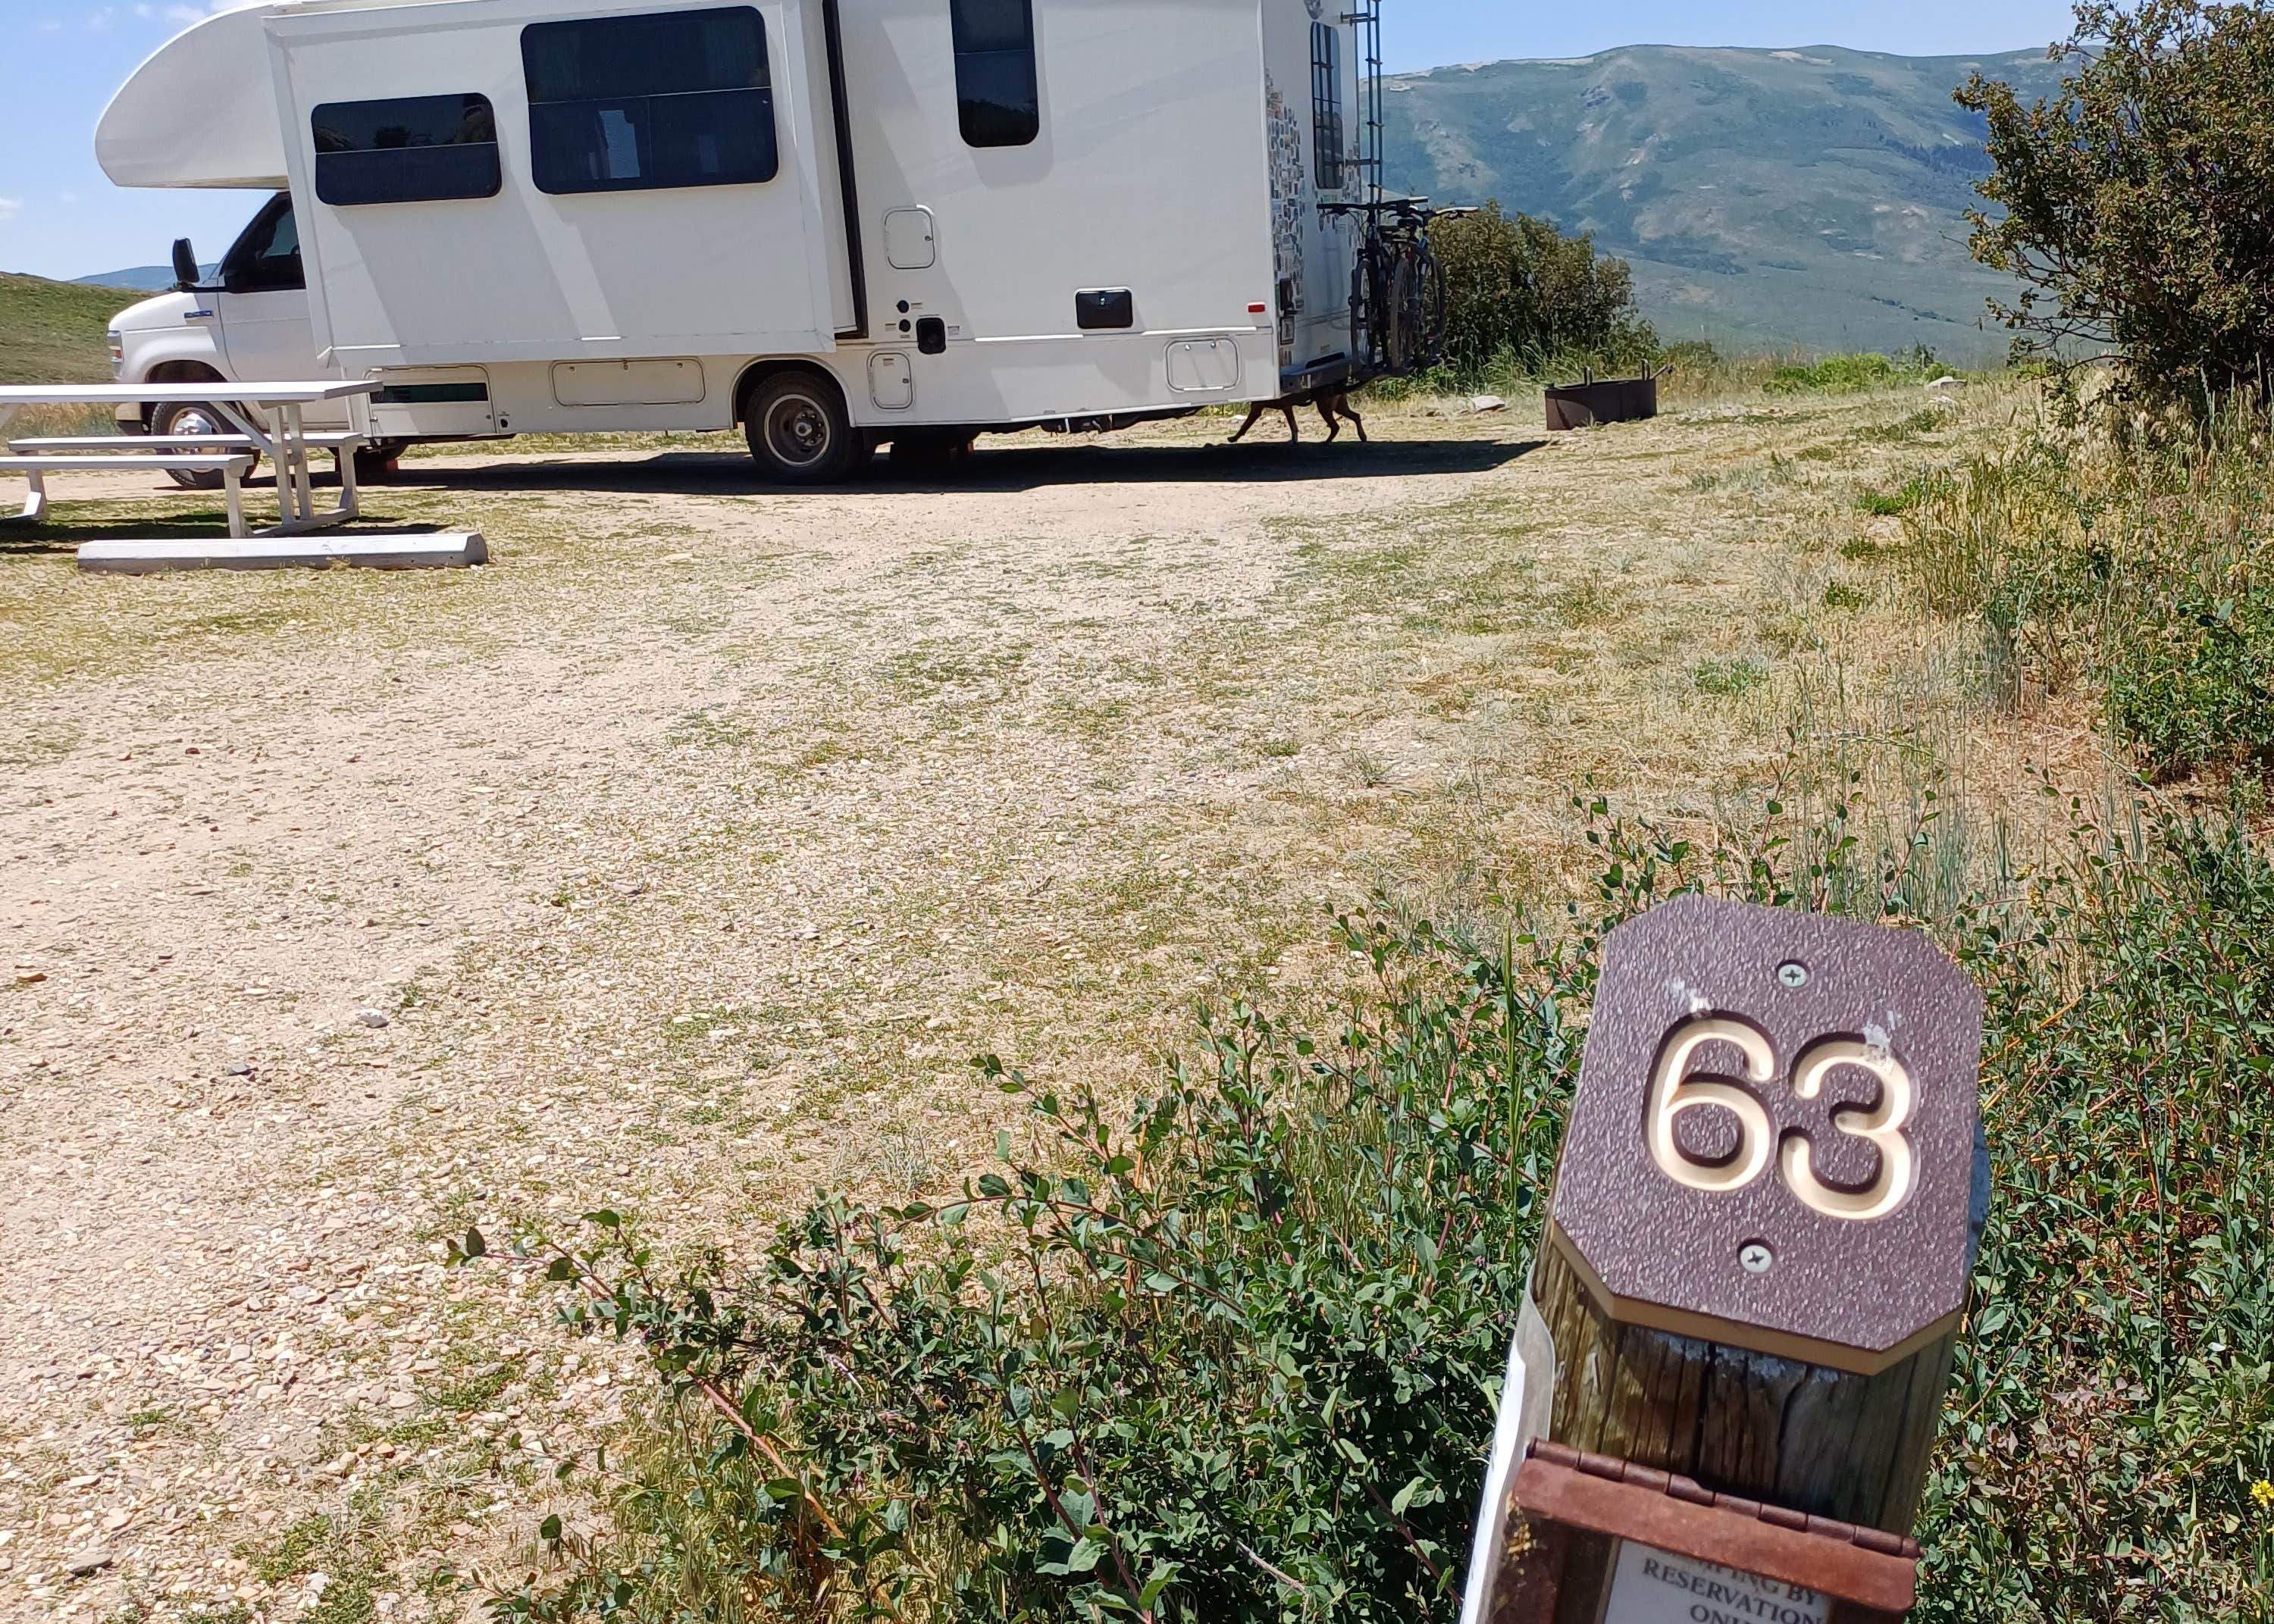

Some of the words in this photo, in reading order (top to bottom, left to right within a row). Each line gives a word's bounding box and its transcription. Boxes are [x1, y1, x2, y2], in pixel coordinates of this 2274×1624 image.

[1643, 1011, 1918, 1219] 63
[1642, 1557, 1823, 1624] RESERVATION
[1787, 1583, 1818, 1605] BY
[1690, 1604, 1752, 1624] ON
